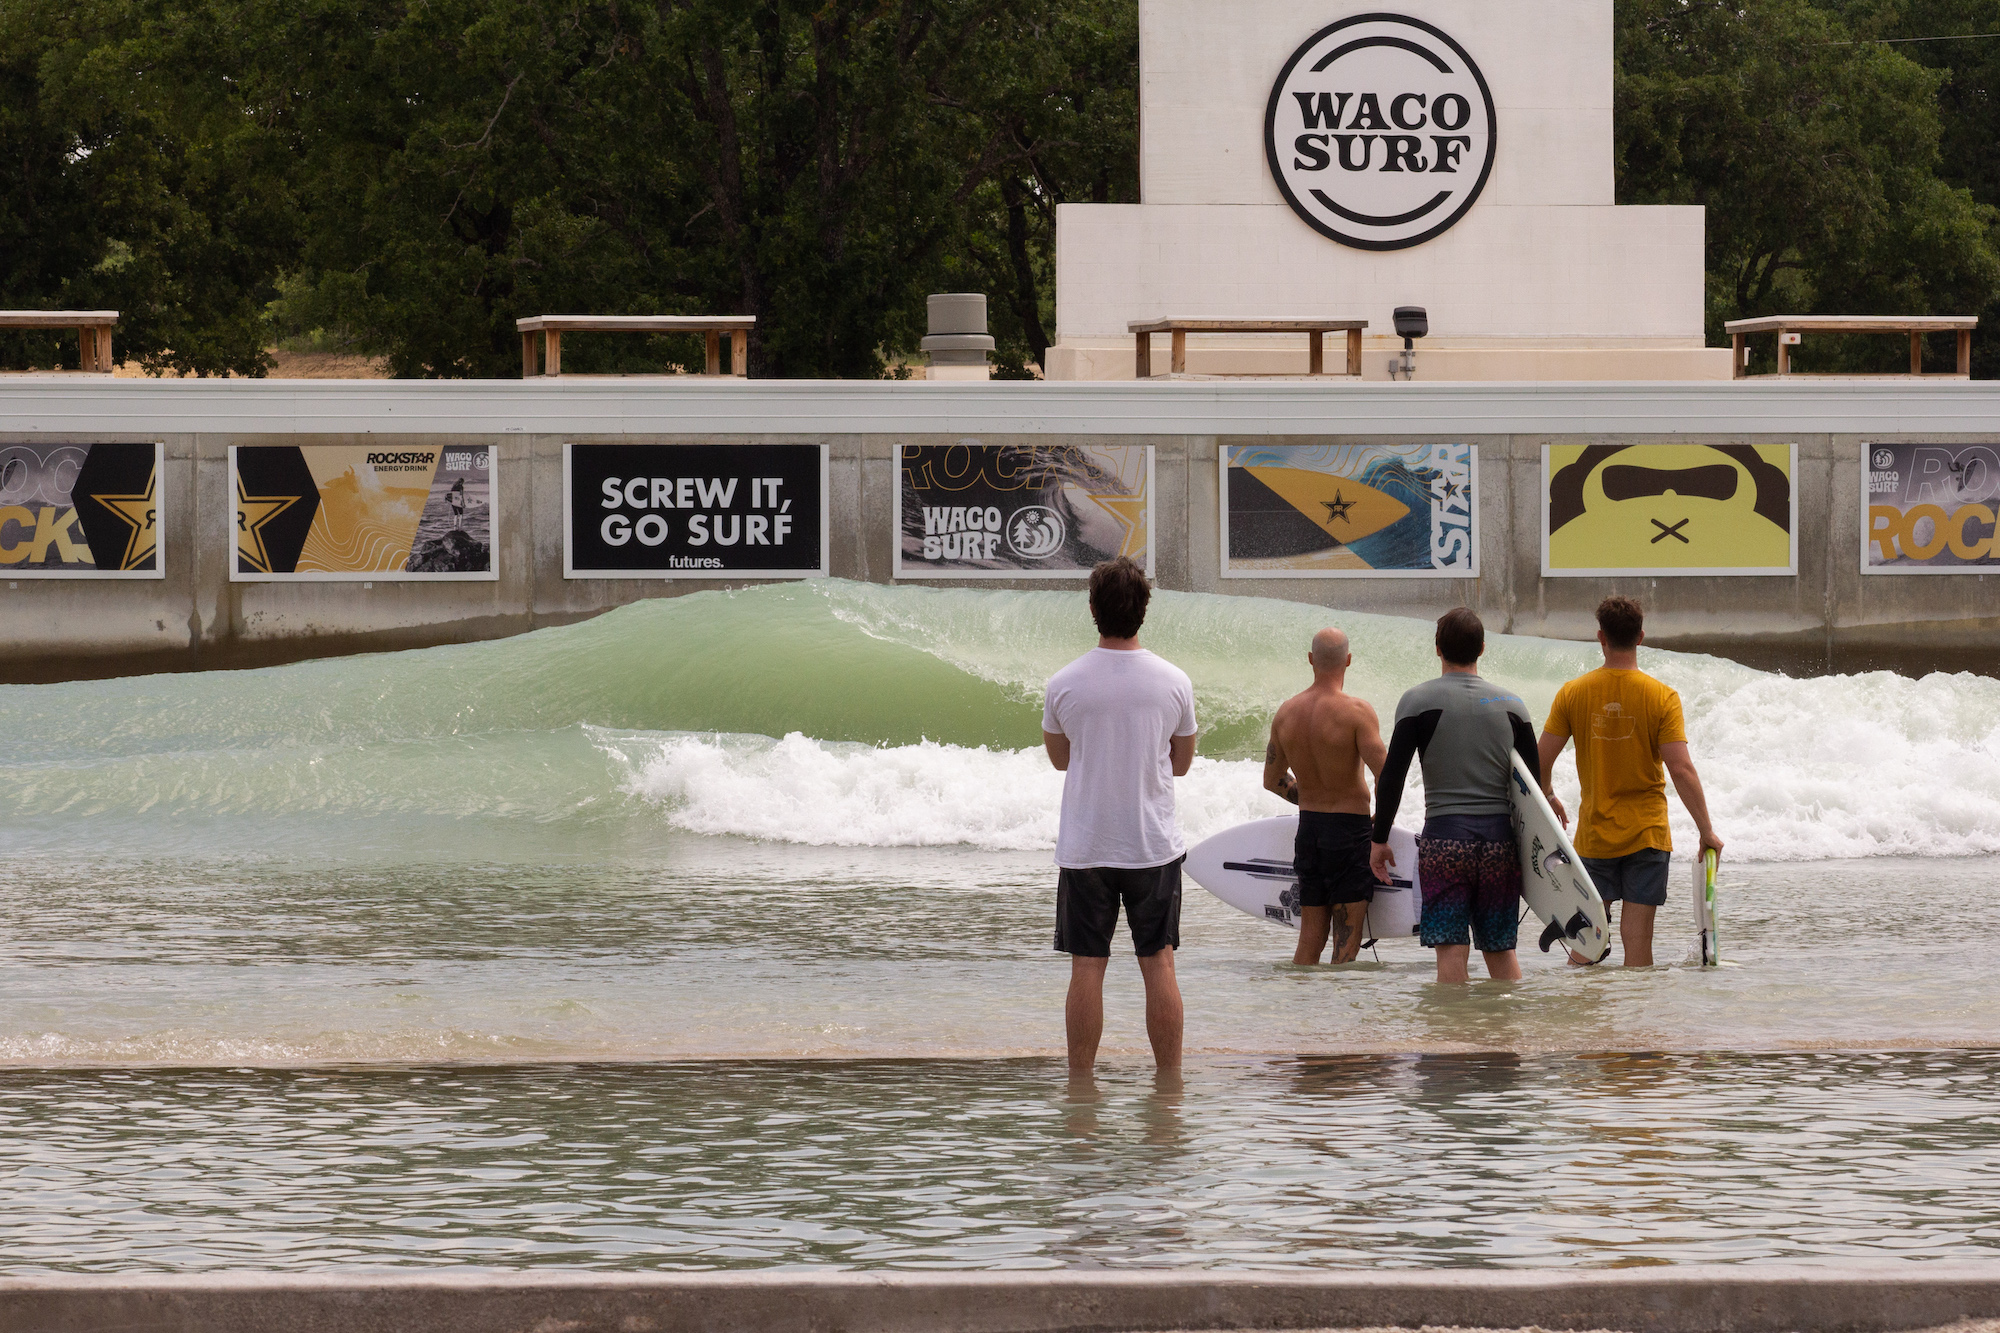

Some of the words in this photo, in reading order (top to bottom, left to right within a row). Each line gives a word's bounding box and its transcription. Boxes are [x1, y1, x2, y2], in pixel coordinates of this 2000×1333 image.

[1292, 92, 1471, 130] WACO
[1294, 134, 1471, 173] SURF
[367, 453, 435, 464] ROCKSTAR
[445, 452, 472, 462] WACO
[445, 461, 472, 471] SURF
[1869, 471, 1899, 482] WACO
[1869, 482, 1899, 493] SURF
[601, 477, 738, 509] SCREW
[752, 477, 792, 513] IT,
[0, 506, 95, 564] CK
[601, 514, 669, 546] GO
[687, 514, 792, 546] SURF
[922, 506, 1002, 535] WACO
[1869, 504, 2000, 560] ROC
[923, 531, 1002, 560] SURF
[669, 555, 724, 568] futures.
